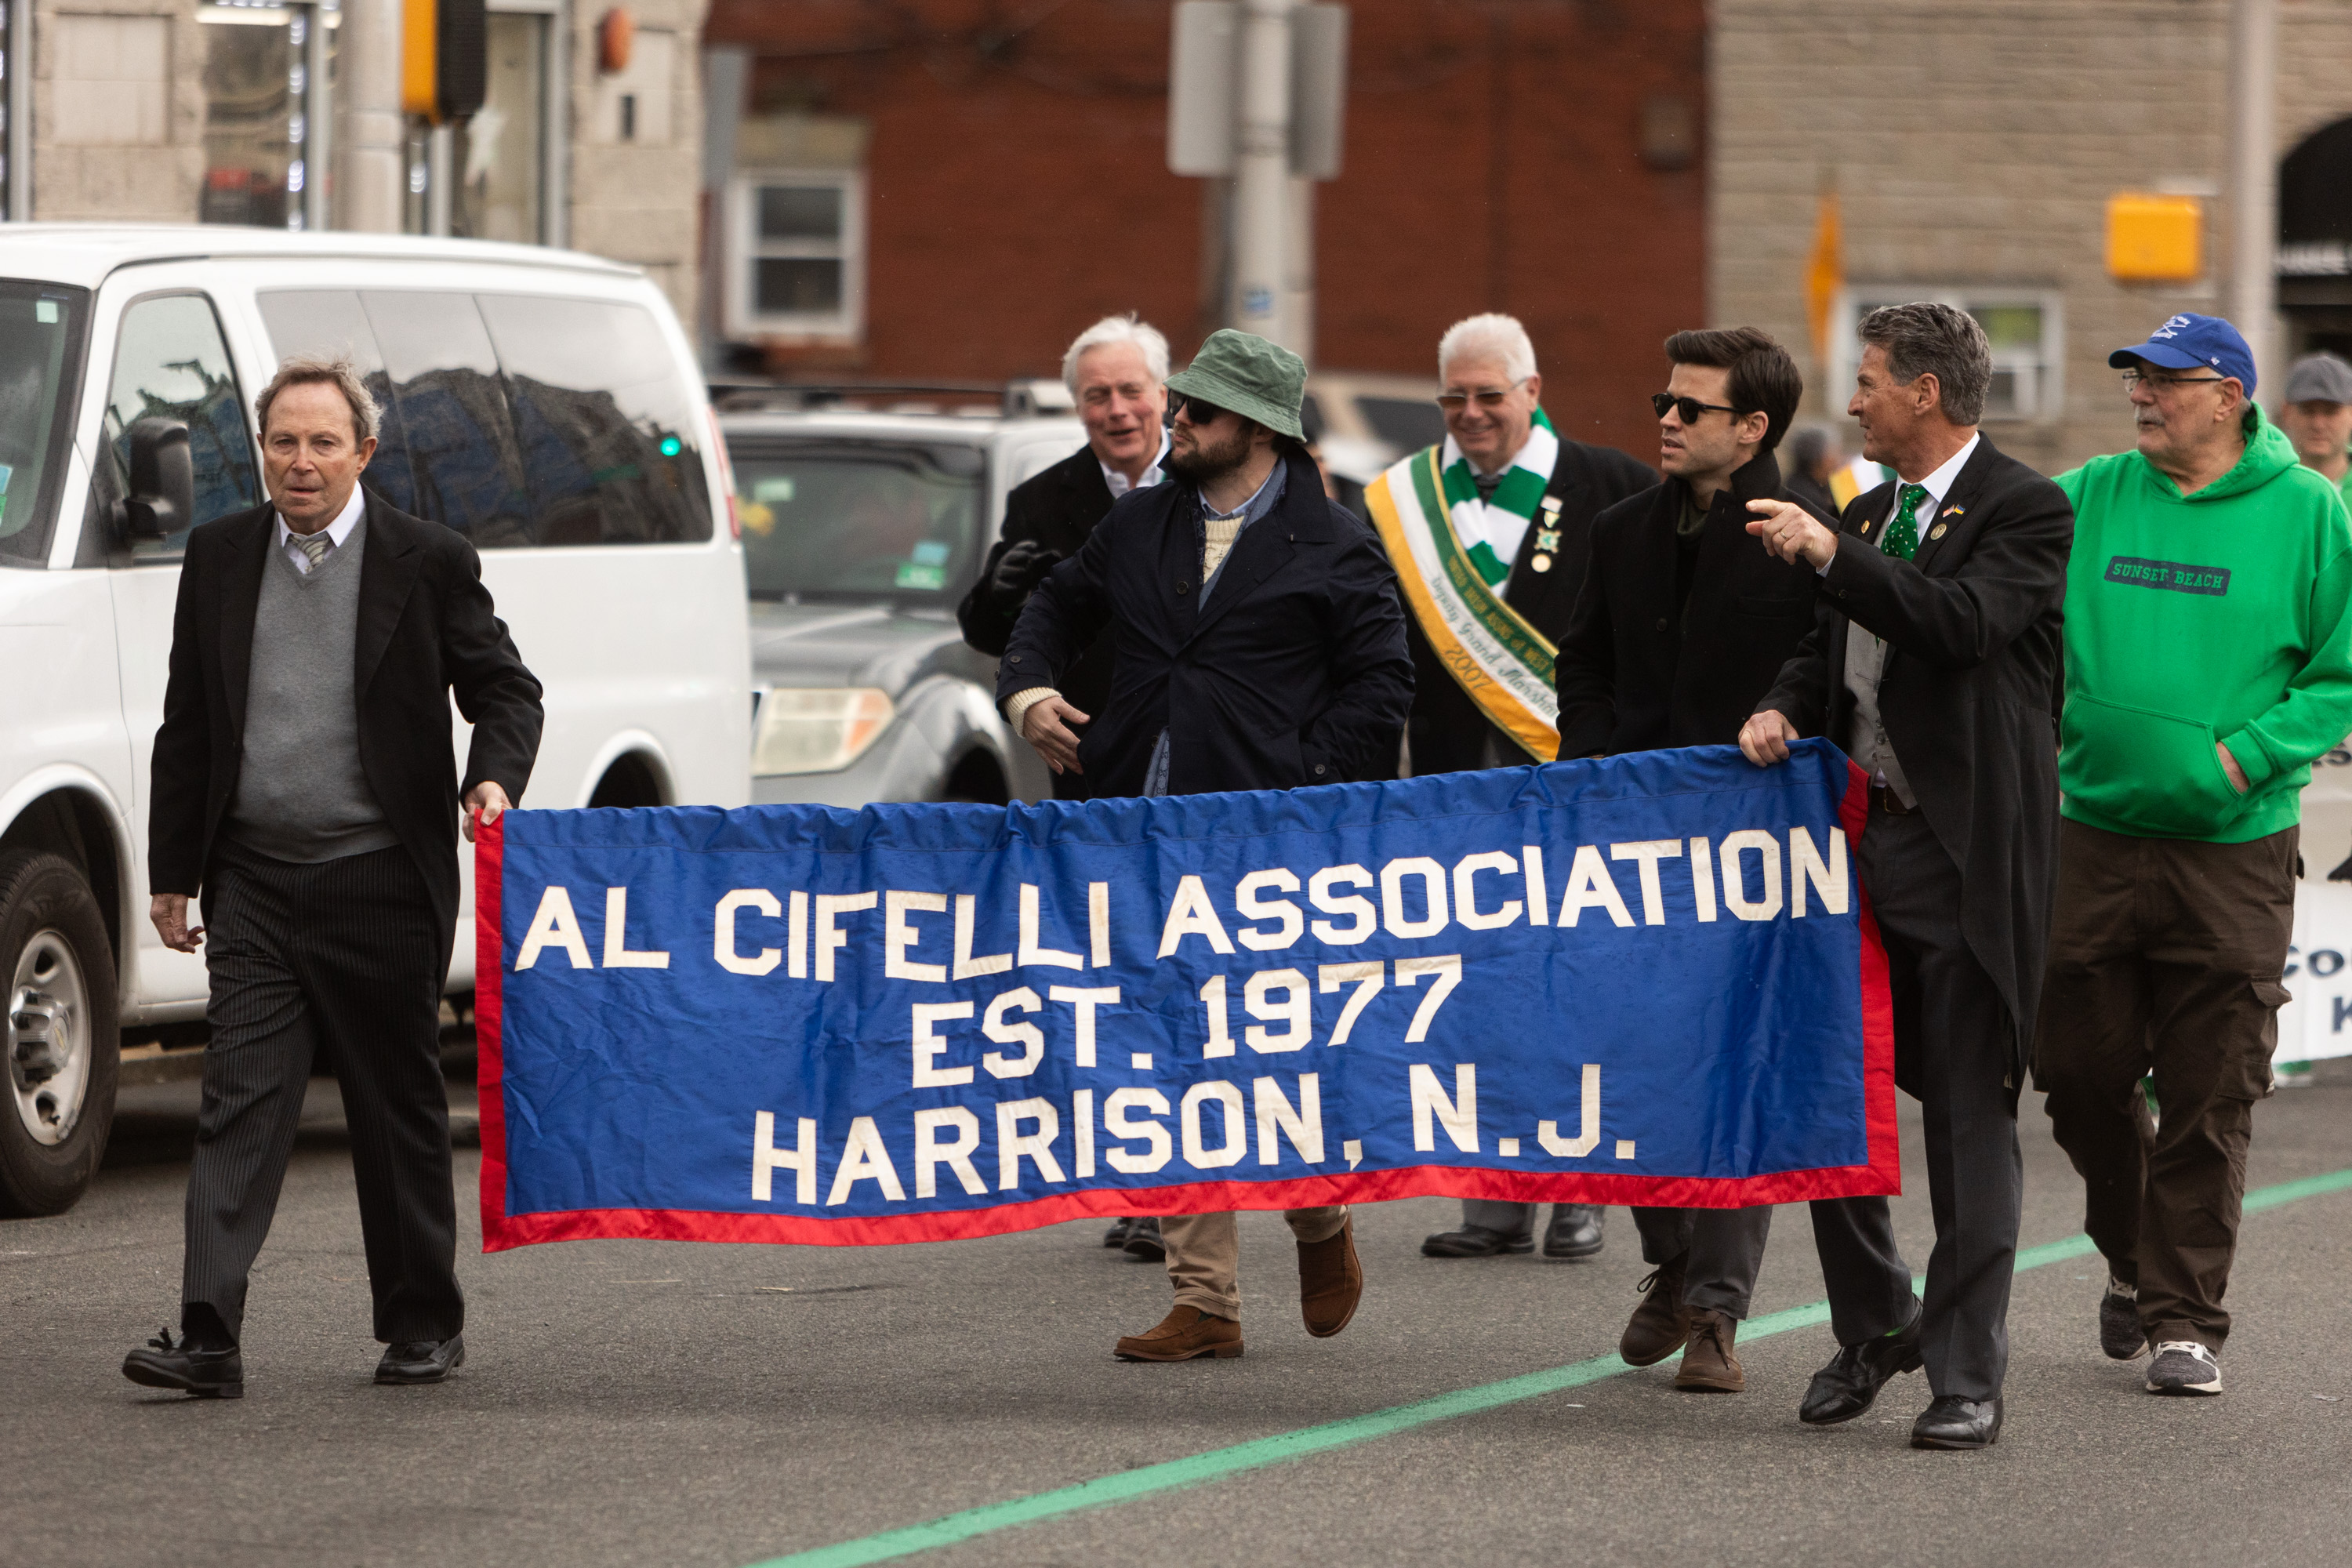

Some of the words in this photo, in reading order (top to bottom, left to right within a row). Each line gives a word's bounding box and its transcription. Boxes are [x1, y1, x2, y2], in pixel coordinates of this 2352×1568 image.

[2112, 562, 2169, 583] SUNSET
[2173, 570, 2224, 589] BEACH
[1444, 644, 1493, 691] 2007
[1457, 622, 1503, 666] Grand
[514, 885, 671, 972] AL
[713, 877, 1111, 984] CIFELLI
[1156, 826, 1849, 961] ASSOCIATION
[911, 984, 1153, 1090] EST.
[1199, 953, 1464, 1061] 1977
[750, 1071, 1364, 1207] HARRISON,
[1408, 1062, 1636, 1170] N.J.
